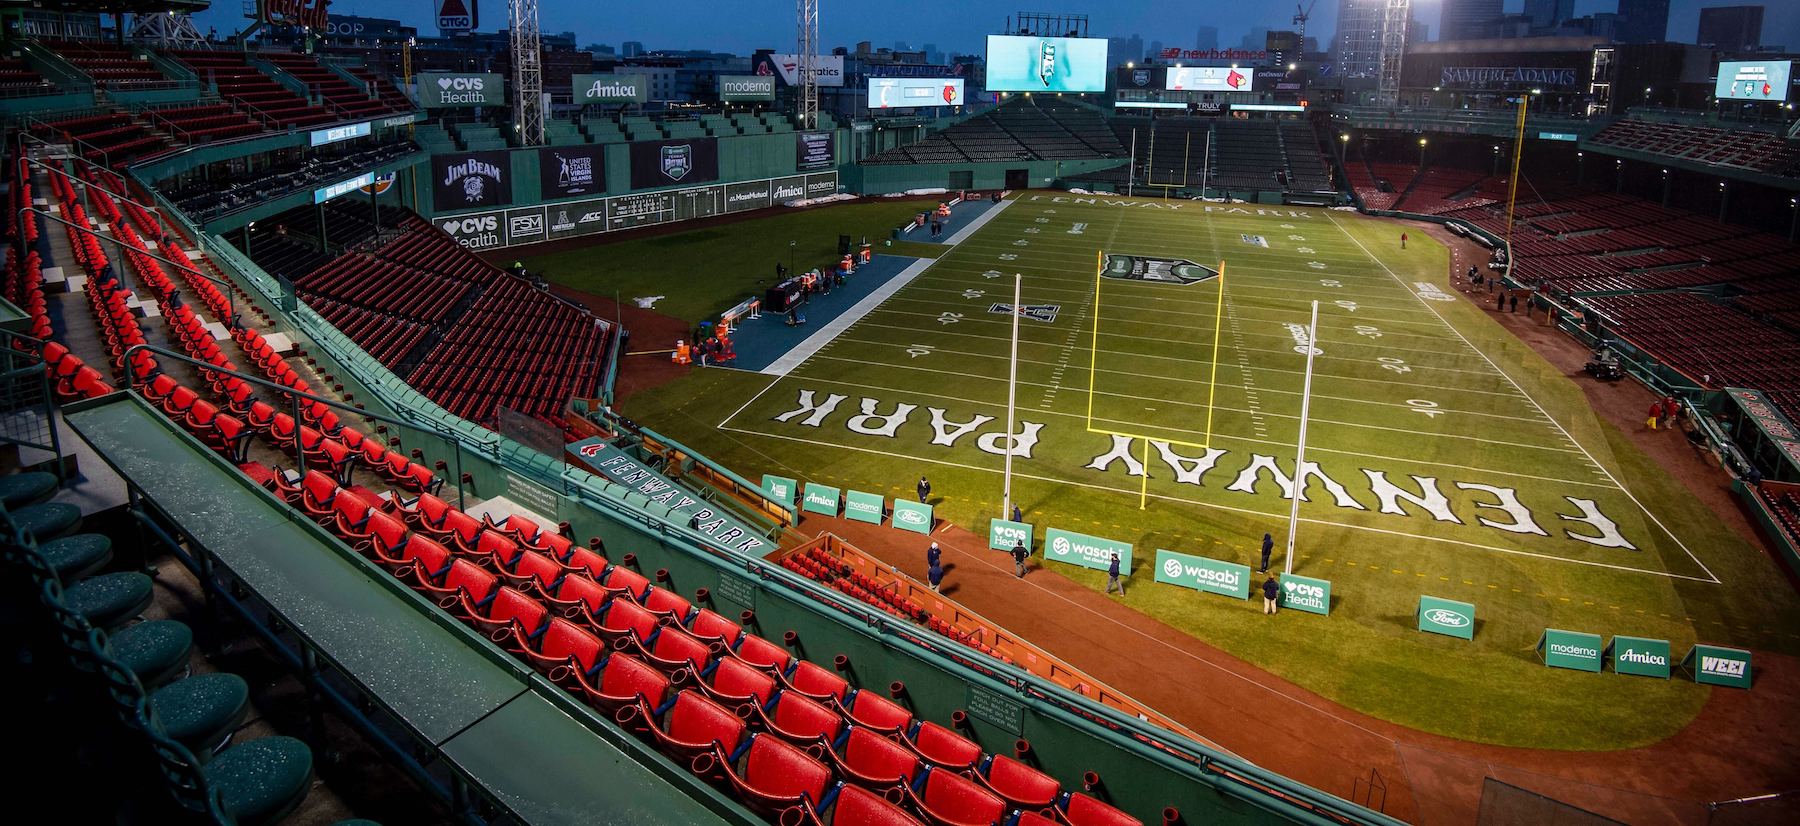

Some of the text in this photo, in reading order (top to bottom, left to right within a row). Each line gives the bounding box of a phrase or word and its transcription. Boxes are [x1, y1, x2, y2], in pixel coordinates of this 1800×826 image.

[439, 17, 469, 27] CITGO
[1183, 48, 1266, 59] new balance
[1512, 65, 1577, 86] ADAMS
[453, 77, 484, 91] CVS
[586, 79, 637, 98] Amica
[724, 80, 771, 92] moderna
[440, 91, 485, 104] Health
[1197, 102, 1221, 110] TRULY
[568, 156, 592, 165] UNITED
[569, 162, 592, 171] STATES
[664, 156, 689, 171] BOWL
[444, 158, 501, 187] JIM BEAM
[570, 168, 592, 177] VIRGIN
[570, 174, 593, 182] ISLANDS
[773, 185, 804, 199] Amica
[808, 180, 835, 191] moderna
[735, 190, 769, 201] MassMutual
[512, 216, 541, 231] FSM
[579, 211, 602, 223] ACC
[461, 215, 498, 235] CVS
[773, 388, 1641, 552] FENWAY PARK
[600, 455, 696, 511] FENWAY
[691, 508, 765, 554] PARK
[805, 492, 836, 508] Amica
[848, 500, 879, 512] moderna
[901, 509, 924, 524] Ford
[1004, 526, 1027, 540] CVS
[1184, 564, 1240, 586] wasabi
[1296, 581, 1325, 597] CVS
[1432, 610, 1461, 625] Ford
[1550, 643, 1597, 658] moderna
[1620, 648, 1666, 666] Amica
[1701, 655, 1747, 676] WEEI
